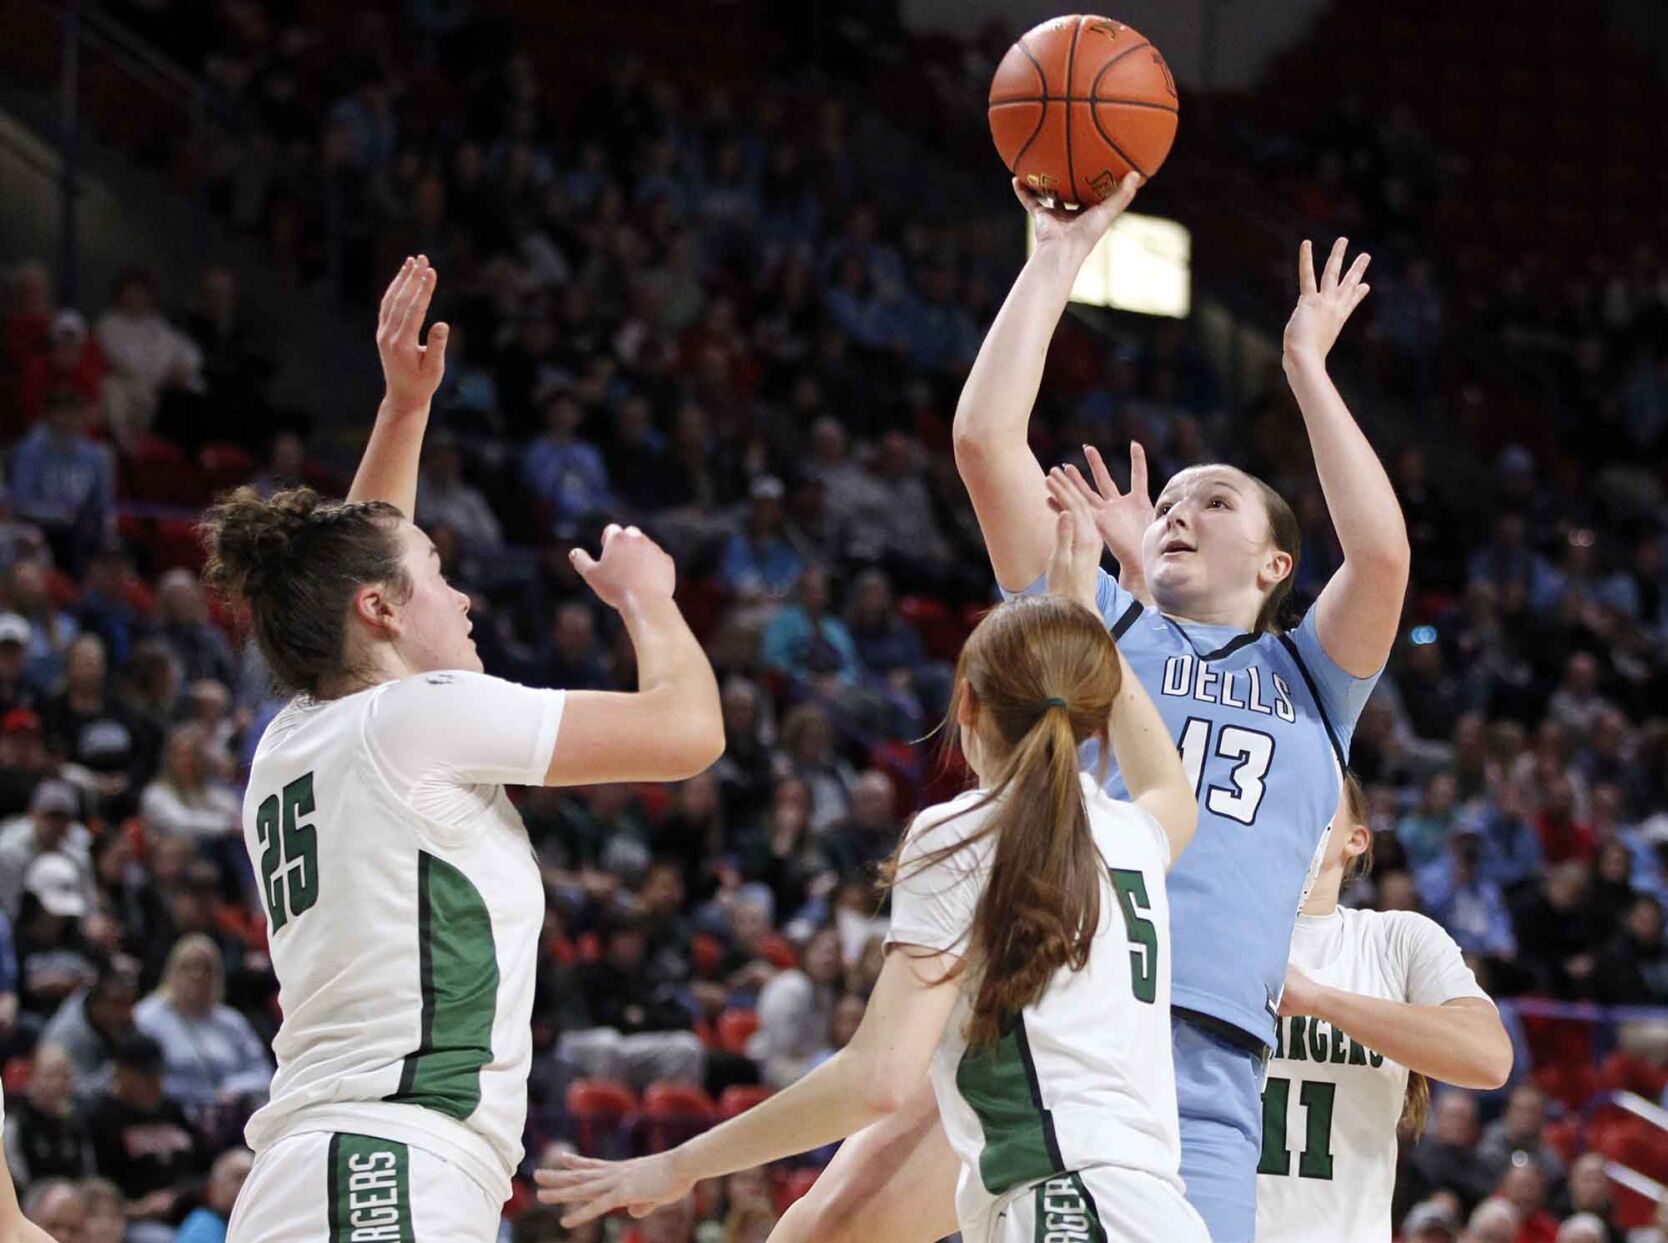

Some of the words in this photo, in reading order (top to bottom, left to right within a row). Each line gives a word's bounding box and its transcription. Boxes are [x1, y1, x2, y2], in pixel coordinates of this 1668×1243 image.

[1161, 654, 1296, 724] DELLS
[1177, 716, 1276, 827] 13
[256, 770, 319, 937] 25
[1107, 867, 1158, 1005] 5
[1256, 1077, 1336, 1180] 11
